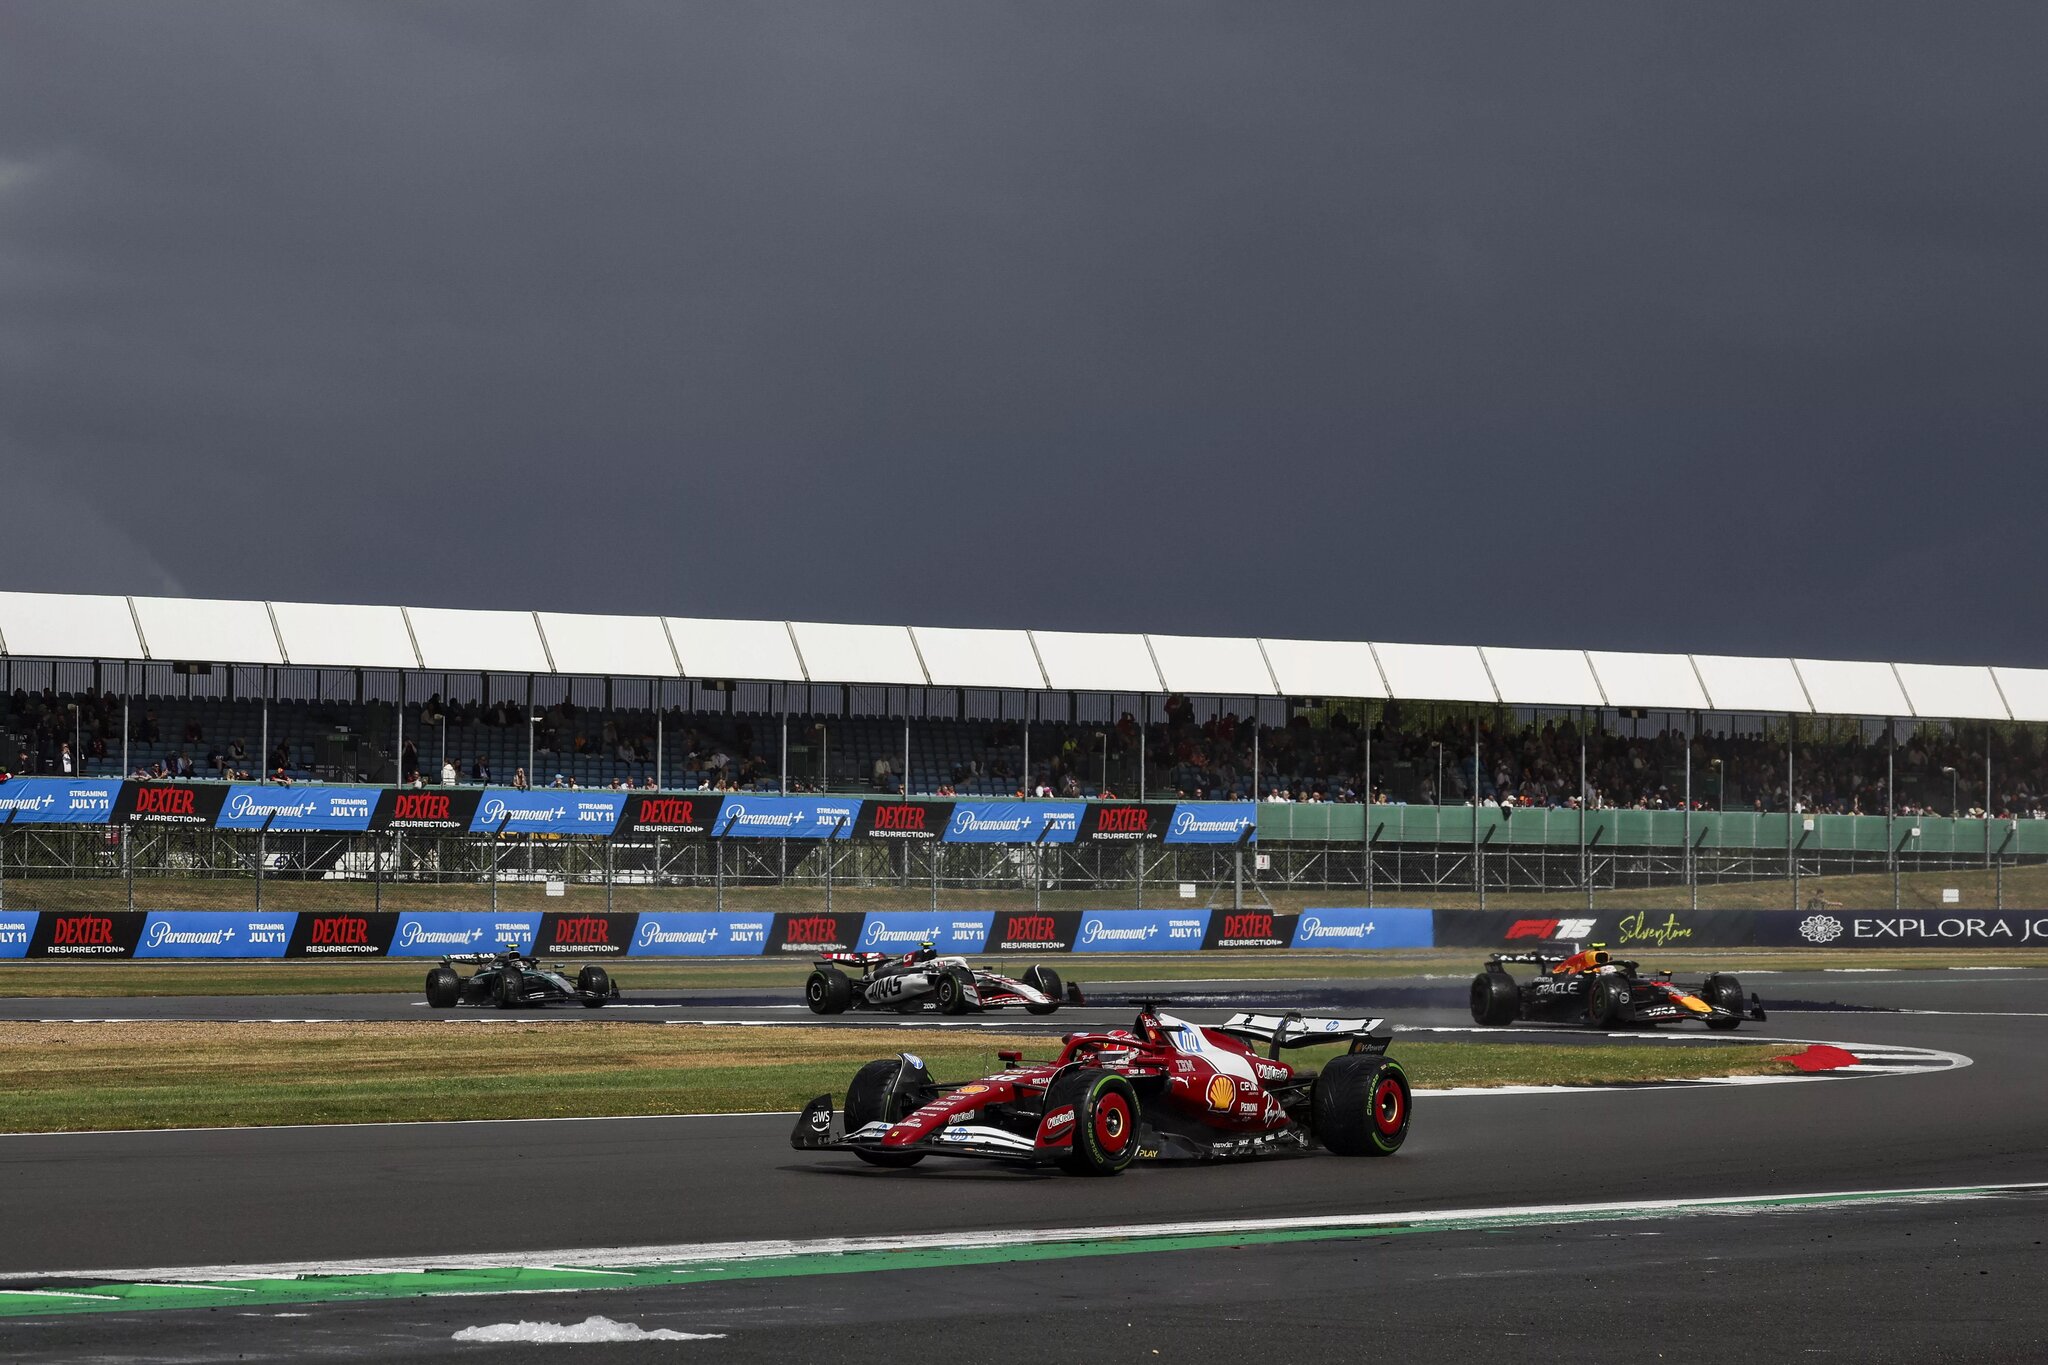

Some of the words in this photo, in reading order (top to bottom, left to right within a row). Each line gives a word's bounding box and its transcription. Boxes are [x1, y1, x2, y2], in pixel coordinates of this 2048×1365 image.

[69, 790, 107, 798] STREAMING
[136, 785, 195, 814] DEXTER
[70, 799, 96, 808] JULY
[100, 800, 108, 808] 11
[229, 795, 316, 819] Paramount+
[395, 791, 449, 818] DEXTER
[640, 797, 692, 823] DEXTER
[331, 807, 356, 816] JULY
[359, 808, 367, 816] 11
[578, 812, 603, 821] JULY
[606, 812, 614, 821] 11
[723, 804, 804, 827] Paramount+
[875, 805, 925, 829] DEXTER
[953, 810, 1031, 834] Paramount+
[1068, 821, 1075, 829] 11
[1098, 807, 1148, 831] DEXTER
[1175, 812, 1249, 835] Paramount+
[634, 824, 698, 833] RESURRECTION
[869, 830, 929, 839] RESURRECTION
[1093, 832, 1152, 840] RESURRECTIN
[54, 914, 114, 944] DEXTER
[312, 914, 368, 943] DEXTER
[556, 915, 608, 943] DEXTER
[788, 915, 836, 943] DEXTER
[1007, 914, 1054, 941] DEXTER
[1082, 920, 1158, 944] Paramount+
[1224, 912, 1272, 938] DEXTER
[1300, 917, 1375, 942] Paramount+
[1854, 919, 2013, 937] EXPLORA
[17, 933, 26, 942] 11
[147, 921, 235, 948] Paramount+
[249, 933, 274, 942] JULY
[277, 933, 285, 942] 11
[400, 921, 483, 948] Paramount+
[496, 933, 520, 942] JULY
[523, 932, 530, 941] 11
[638, 921, 718, 947] Paramount+
[731, 932, 753, 941] JULY
[755, 932, 763, 941] 11
[865, 921, 941, 946] Paramount+
[953, 931, 975, 940] JULY
[977, 931, 984, 939] 11
[1170, 928, 1195, 937] JULY
[1194, 928, 1201, 937] 11
[306, 945, 372, 953] RESURRECTION
[550, 944, 614, 953] RESURRECTION
[782, 943, 842, 951] RESURRECTION
[1001, 941, 1059, 949] RESURRECTION
[1536, 982, 1579, 996] ORACLE
[1176, 1060, 1196, 1073] IBM
[1240, 1102, 1258, 1112] PERONI
[812, 1111, 830, 1123] aws
[1139, 1149, 1158, 1158] PLAY
